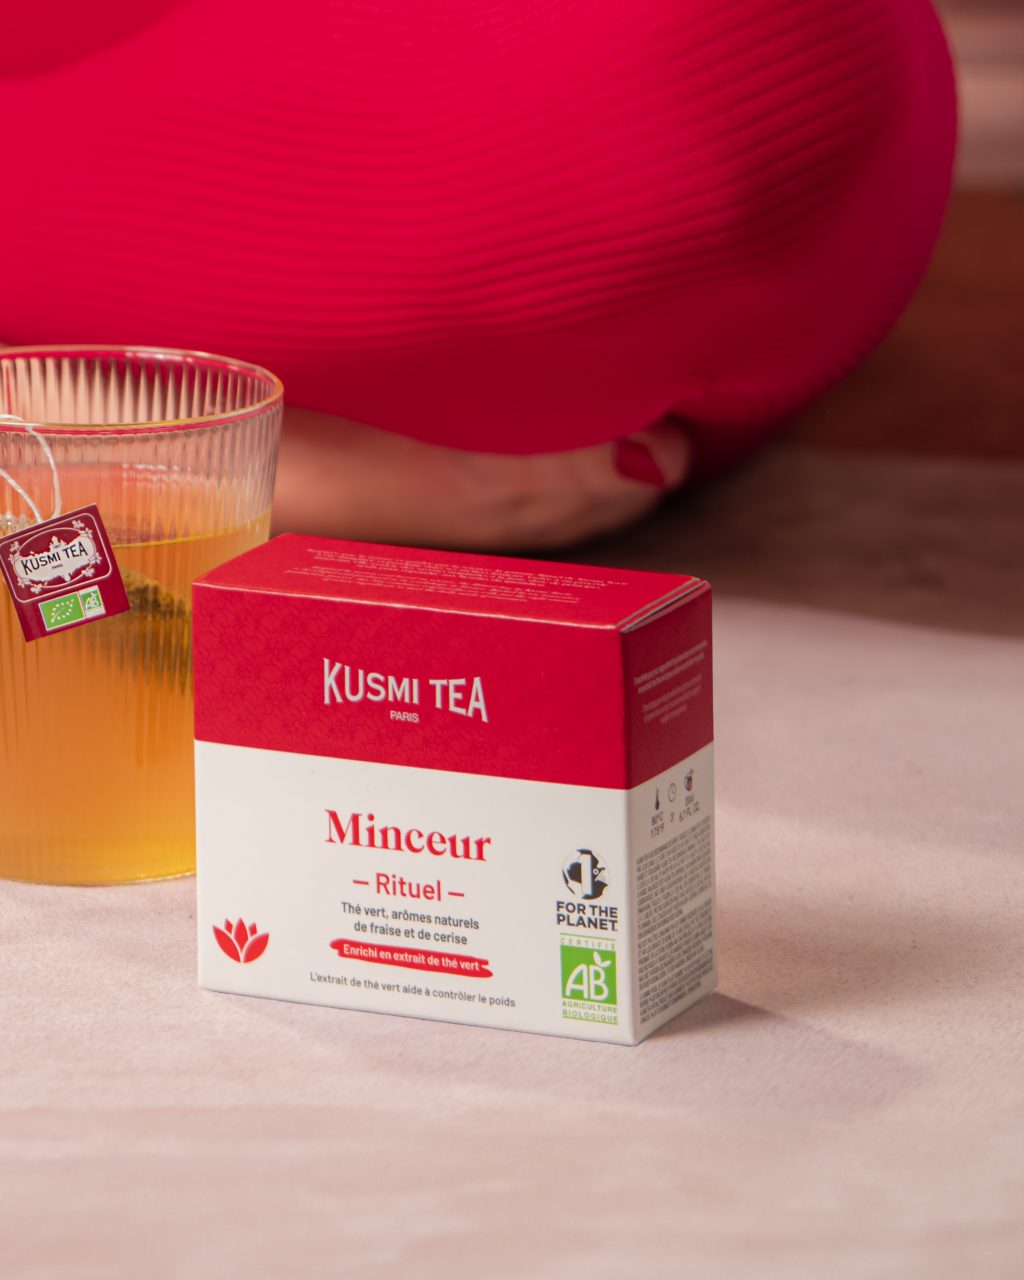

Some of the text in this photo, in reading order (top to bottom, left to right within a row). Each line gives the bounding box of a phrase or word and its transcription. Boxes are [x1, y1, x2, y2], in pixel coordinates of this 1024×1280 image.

[21, 541, 88, 575] KUSMI TEA
[323, 657, 488, 723] KUSMI TEA
[390, 710, 419, 723] PARIS
[324, 809, 491, 861] Minceur
[376, 872, 441, 901] Rituel
[341, 901, 480, 930] Thé vert, arômes naturels
[556, 901, 618, 918] FOR THE
[354, 920, 468, 945] de fraise et de cerise
[343, 943, 480, 971] Enrichi en extrait de thé vert
[310, 971, 516, 1008] L'extrait de thé vert aide à contrôler le poids
[565, 962, 609, 1001] AB
[562, 1000, 618, 1014] AGRICULTURE
[563, 1009, 618, 1023] BIOLOGIQUE
